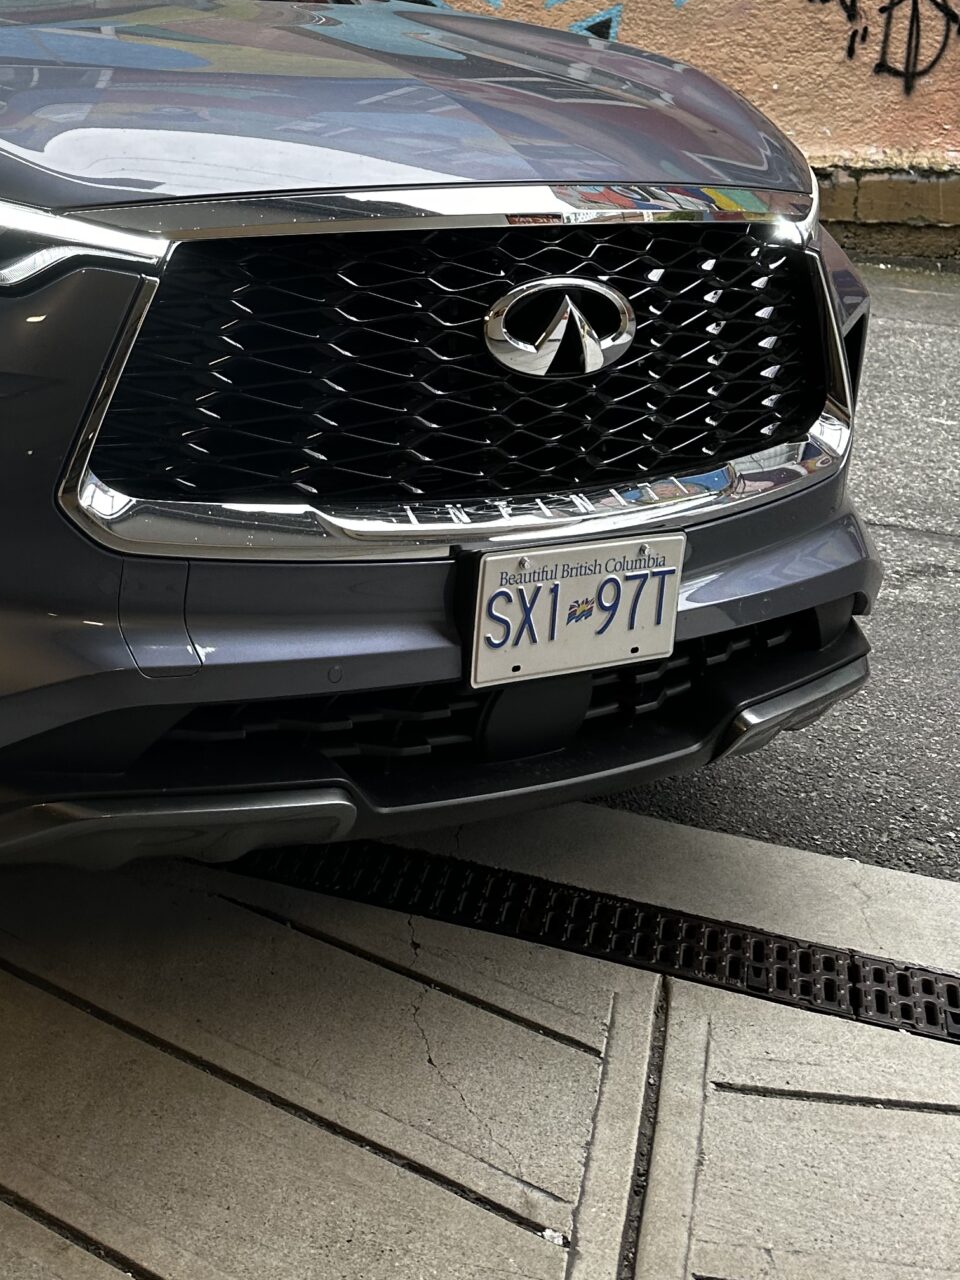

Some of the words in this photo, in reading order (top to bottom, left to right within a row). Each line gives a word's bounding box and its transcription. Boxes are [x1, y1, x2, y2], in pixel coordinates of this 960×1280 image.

[404, 476, 689, 525] INFINITI
[499, 564, 558, 587] Beautiful
[561, 558, 602, 579] British
[604, 554, 666, 572] Columbia
[485, 581, 560, 649] SX1
[595, 567, 676, 635] 97T
